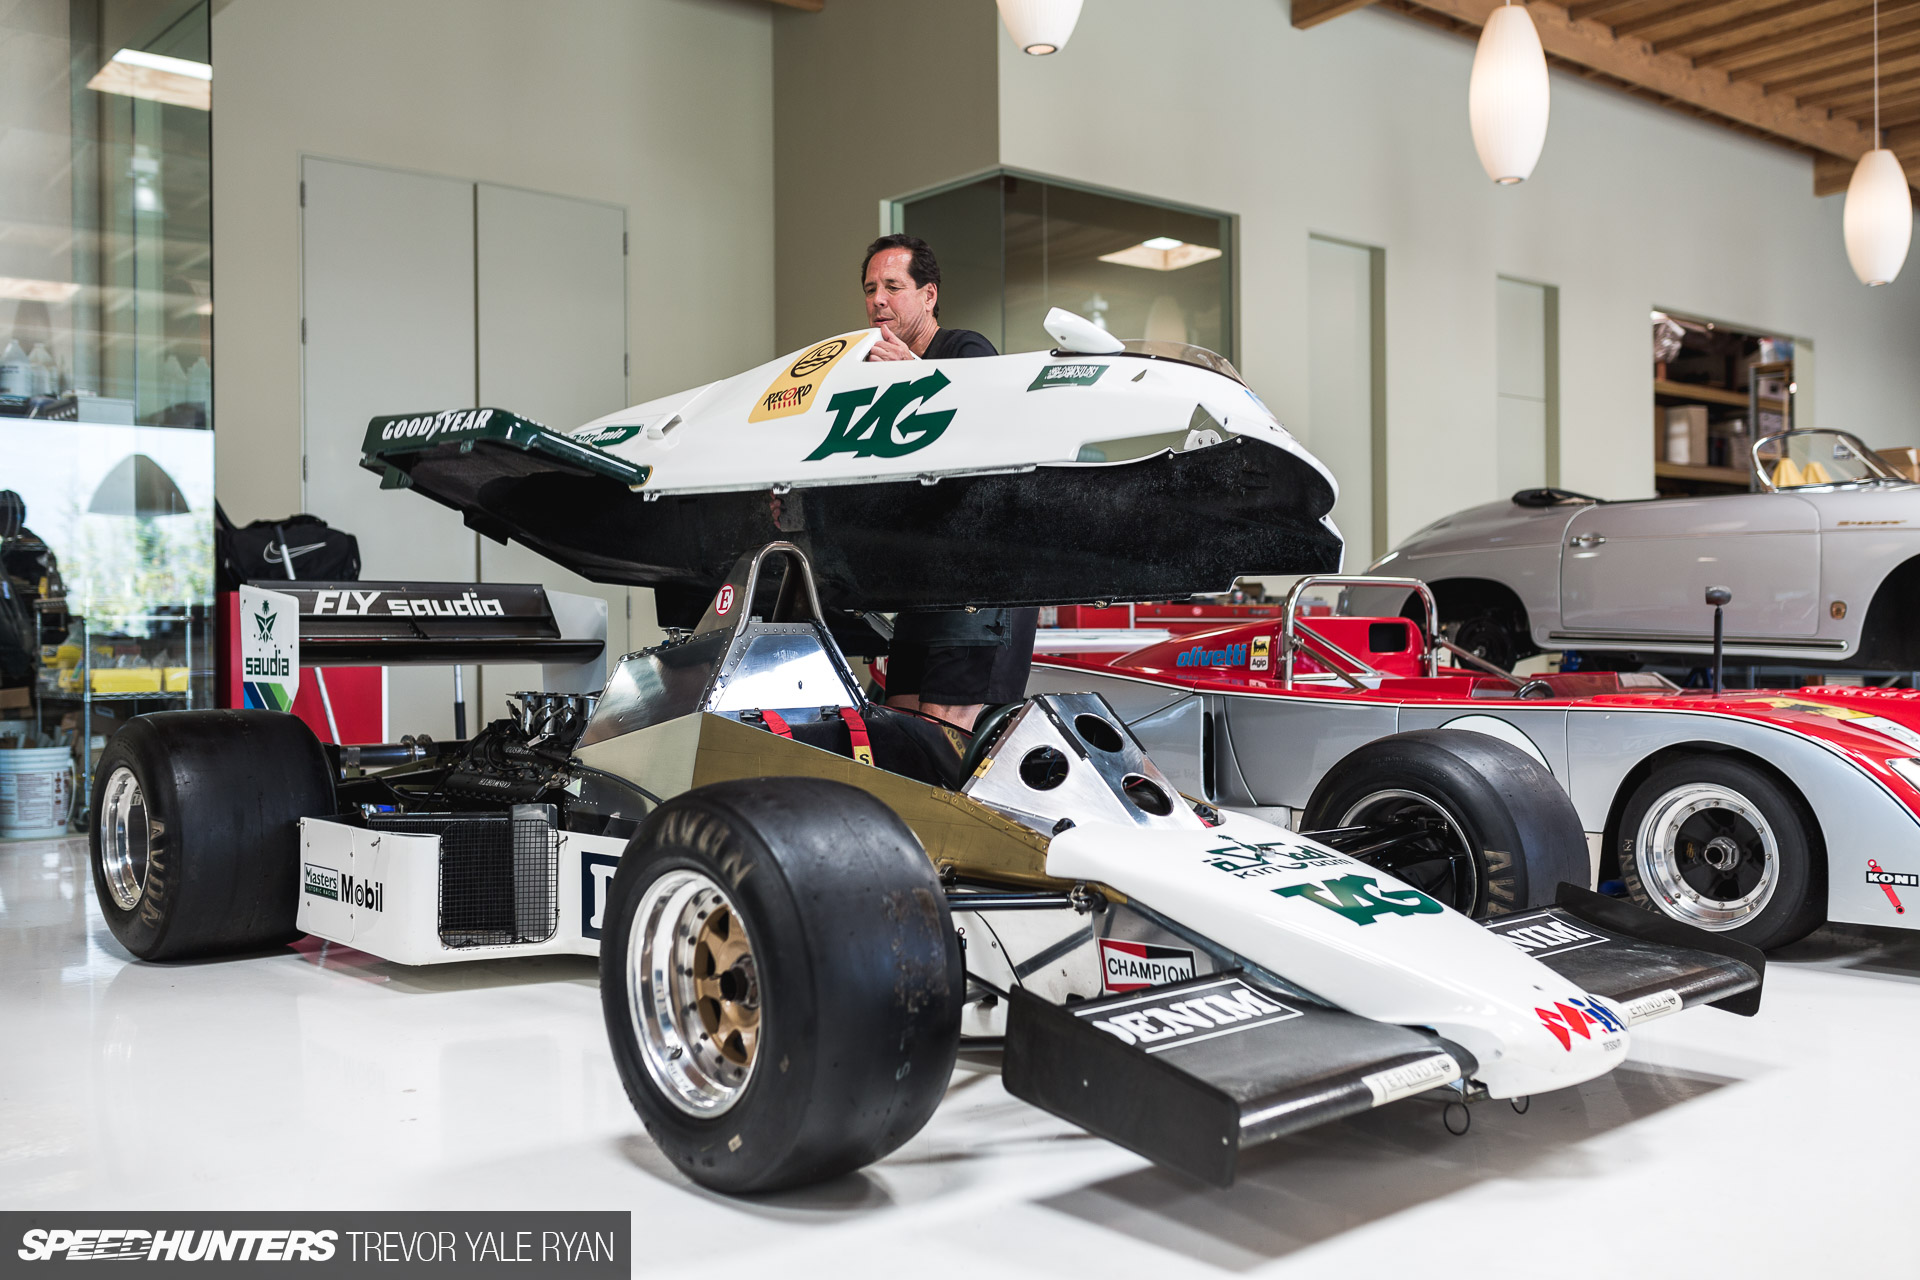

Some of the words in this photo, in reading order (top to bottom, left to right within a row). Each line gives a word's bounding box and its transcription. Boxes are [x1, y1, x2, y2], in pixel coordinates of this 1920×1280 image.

[810, 344, 839, 360] ICI
[763, 383, 813, 411] RECORD
[381, 408, 494, 441] GOODYEAR
[801, 368, 958, 462] TAG
[313, 590, 382, 616] FLY
[386, 592, 505, 616] saudia
[717, 588, 732, 611] E
[245, 649, 290, 677] saudia
[1176, 643, 1248, 667] olivetti
[1251, 658, 1267, 669] Agip
[657, 809, 758, 891] AVON
[140, 818, 166, 929] AVON
[305, 866, 337, 890] Masters
[1867, 872, 1917, 885] KONI
[341, 873, 383, 913] Mobil
[1270, 873, 1445, 927] TAG
[1107, 957, 1193, 983] CHAMPION
